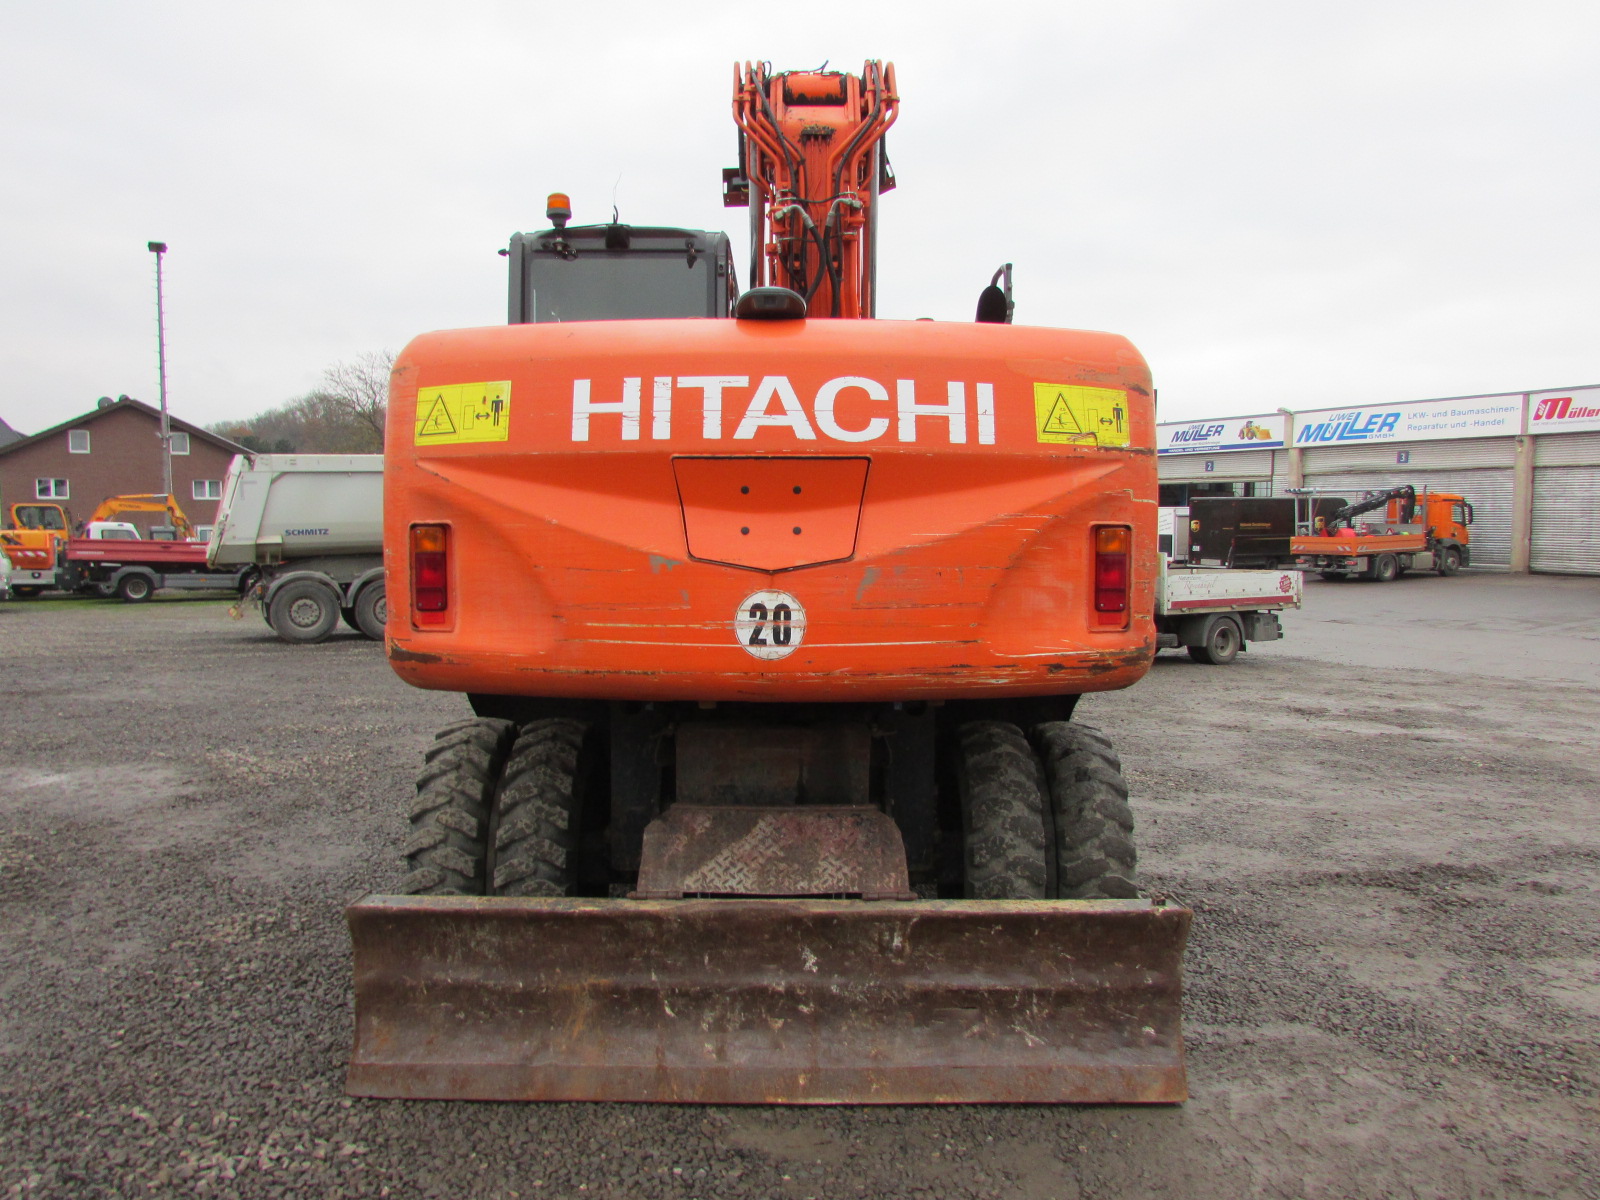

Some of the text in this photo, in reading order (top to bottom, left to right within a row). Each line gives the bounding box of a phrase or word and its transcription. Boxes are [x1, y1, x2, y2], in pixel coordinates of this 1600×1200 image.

[571, 376, 996, 445] HITACHI
[1328, 412, 1355, 422] UWE
[1407, 405, 1520, 420] LKW- und Baumaschinen-
[1296, 411, 1401, 443] MÜLLER
[1407, 418, 1504, 432] Reparatur und -Handel
[1171, 424, 1225, 443] MÜLLER
[1400, 452, 1406, 461] 3
[1207, 462, 1212, 471] 2
[285, 528, 330, 537] SCHMITZ
[748, 603, 792, 646] 20
